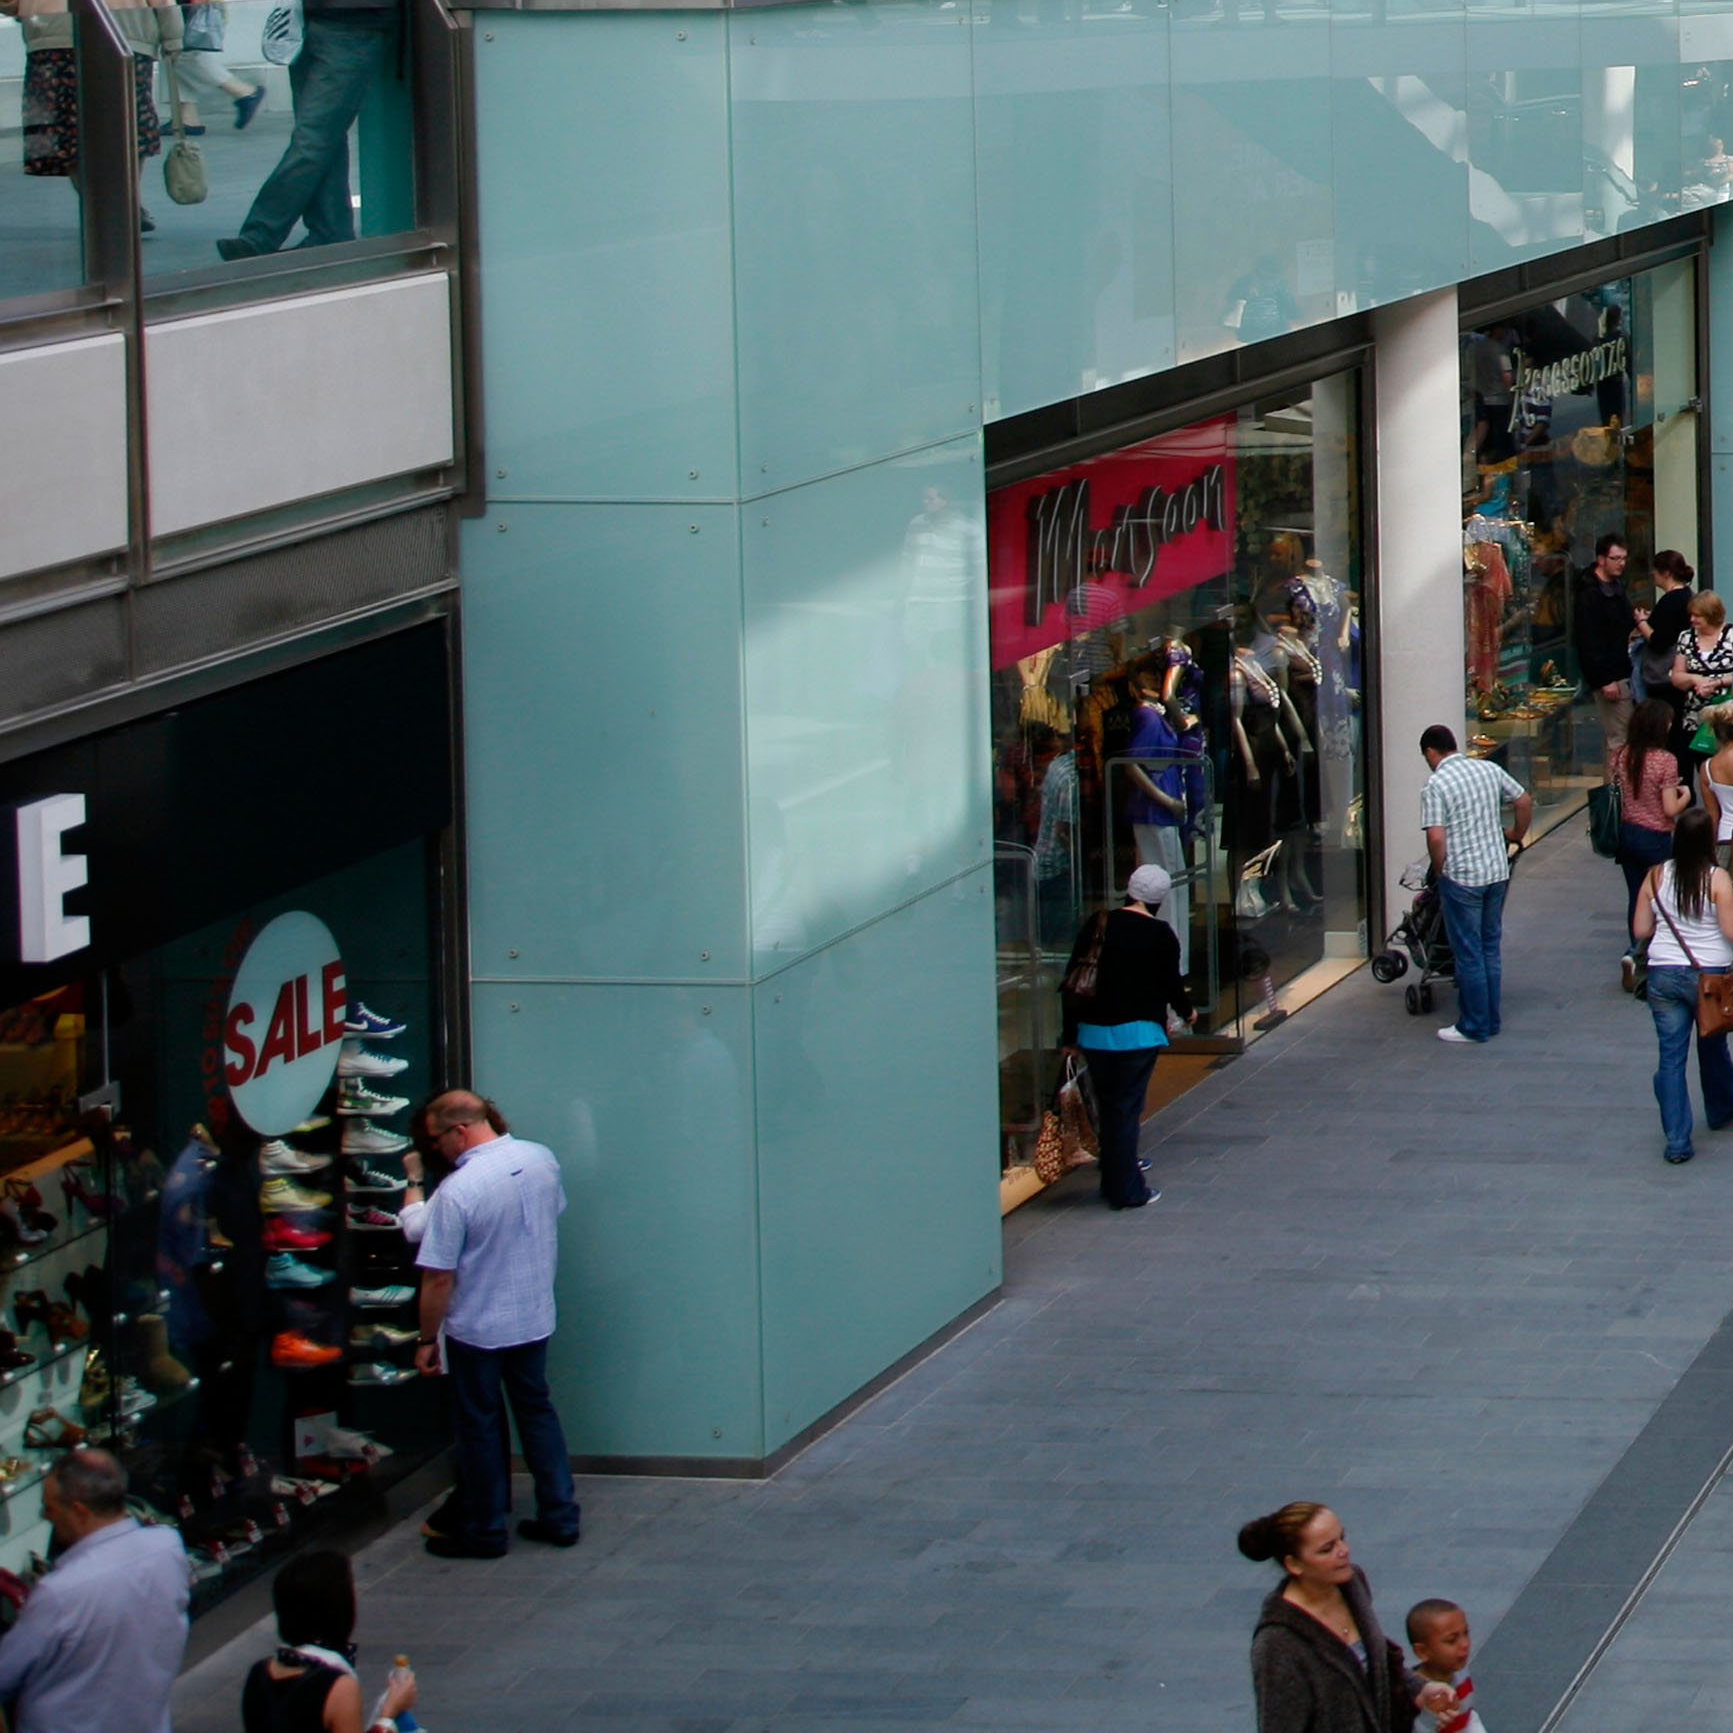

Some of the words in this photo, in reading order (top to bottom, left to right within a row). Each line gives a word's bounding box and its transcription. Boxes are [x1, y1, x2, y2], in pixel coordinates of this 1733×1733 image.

[1507, 337, 1627, 433] Accessorize
[1026, 464, 1228, 627] Monsoon
[224, 959, 347, 1087] SALE
